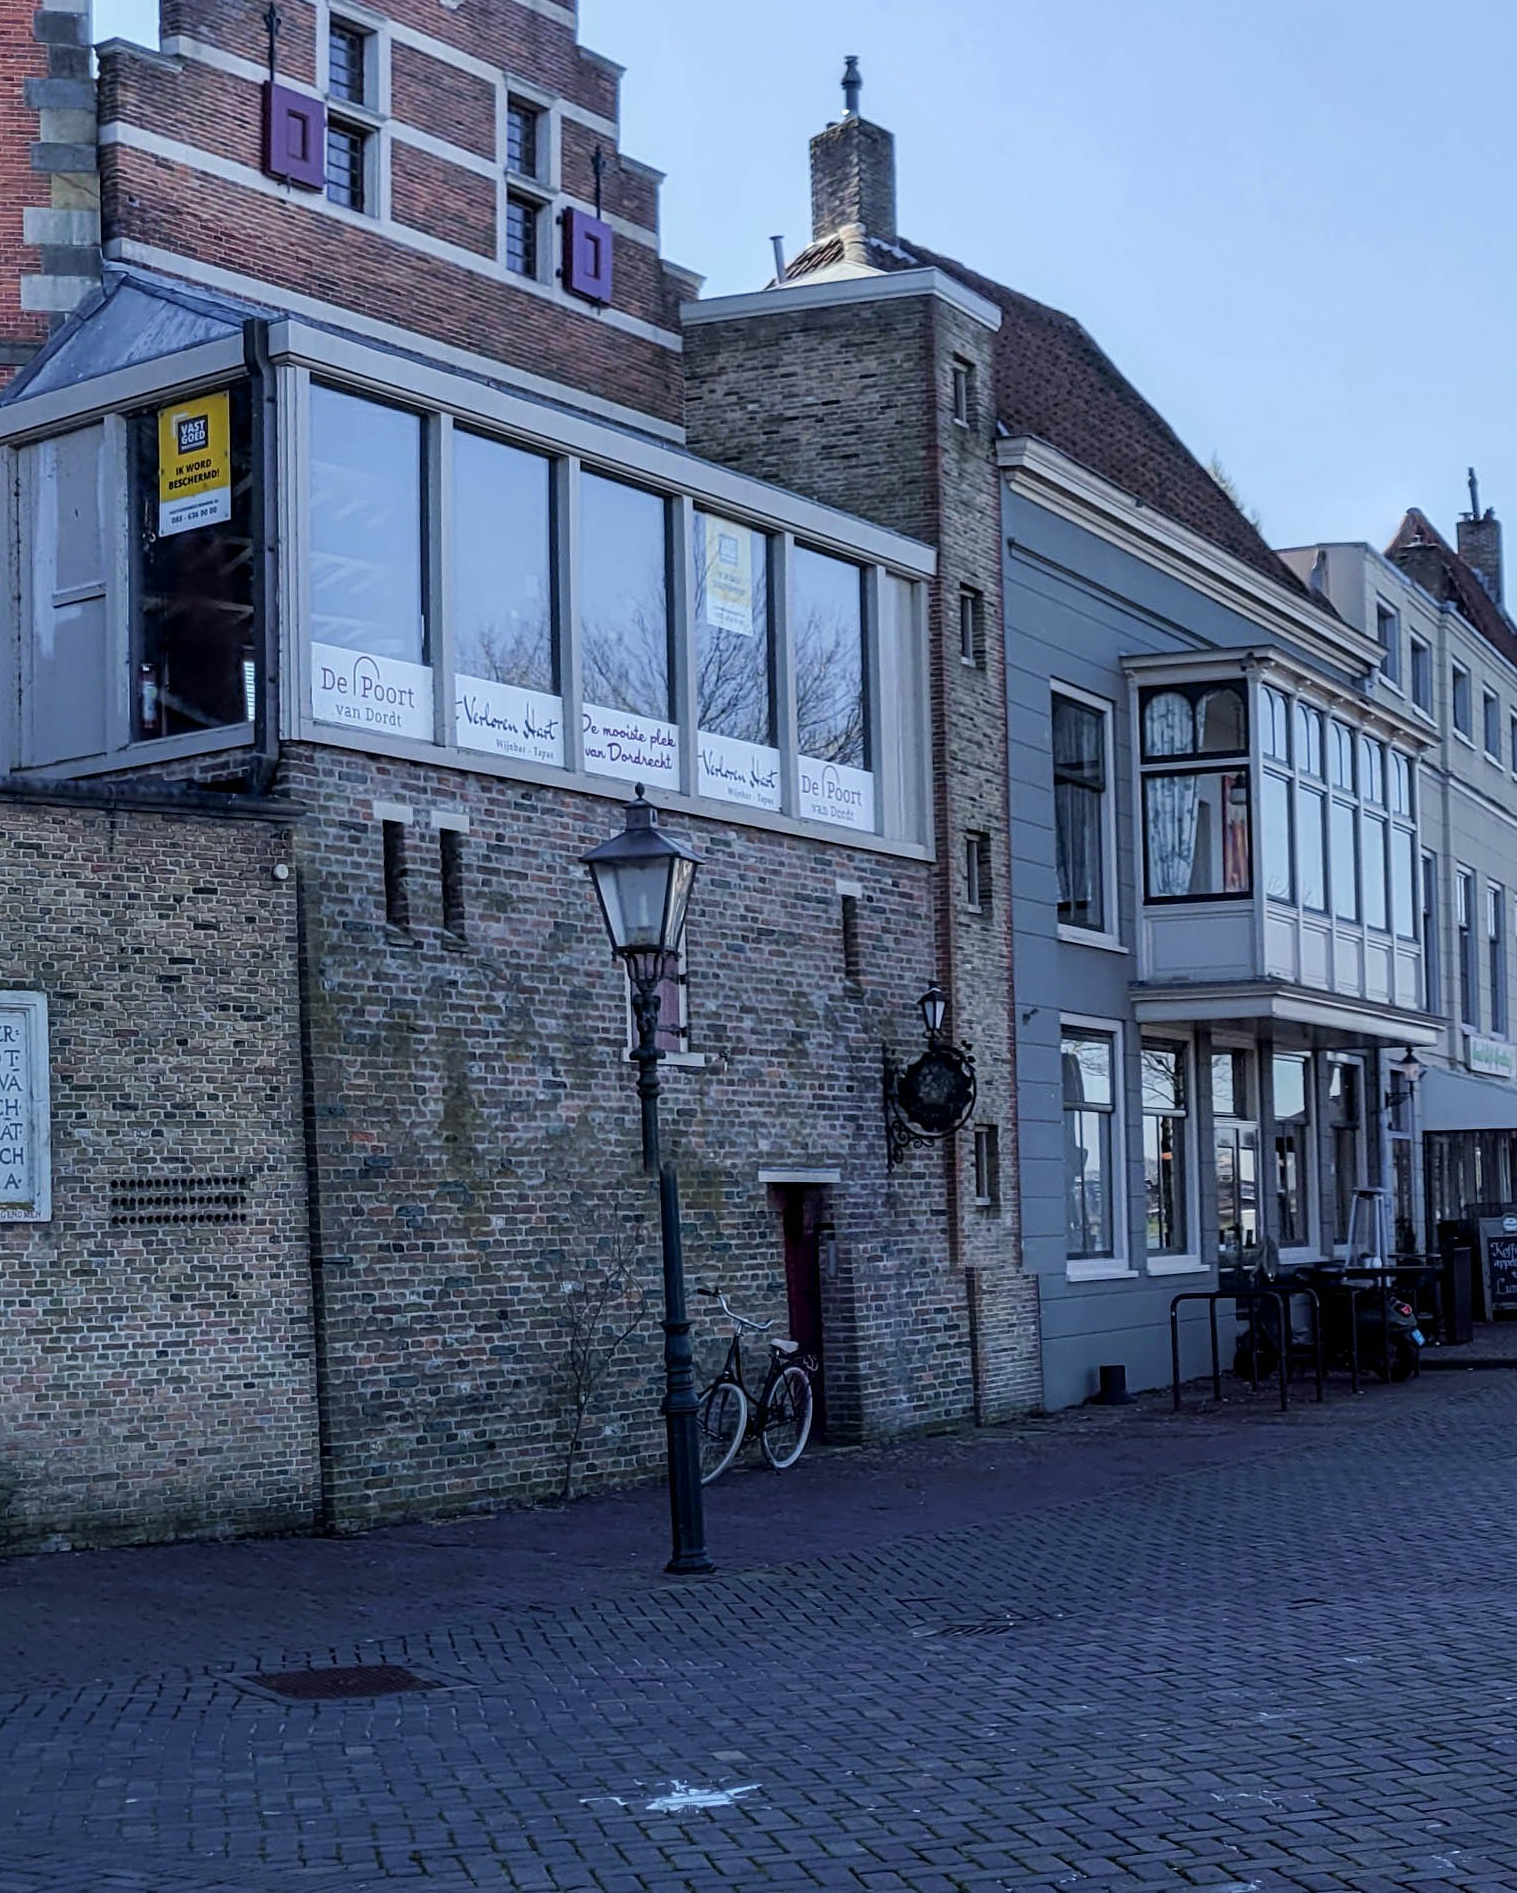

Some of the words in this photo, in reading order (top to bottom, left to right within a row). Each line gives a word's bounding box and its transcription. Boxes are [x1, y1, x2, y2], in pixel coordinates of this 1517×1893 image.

[180, 419, 206, 435] VAST
[181, 430, 206, 445] GOED
[168, 467, 220, 491] BESCHERMD!
[175, 465, 184, 476] IK
[185, 458, 212, 473] WORD
[321, 666, 348, 694] De
[361, 675, 415, 709] Poort
[335, 704, 361, 720] van
[365, 707, 402, 727] Dordt
[463, 694, 519, 734] Verloren
[581, 713, 599, 735] De
[603, 724, 646, 742] mooiste
[650, 728, 676, 751] plek
[585, 747, 606, 759] van
[607, 742, 672, 770] Dordrecht
[801, 774, 819, 796] De
[827, 780, 862, 807] Poort
